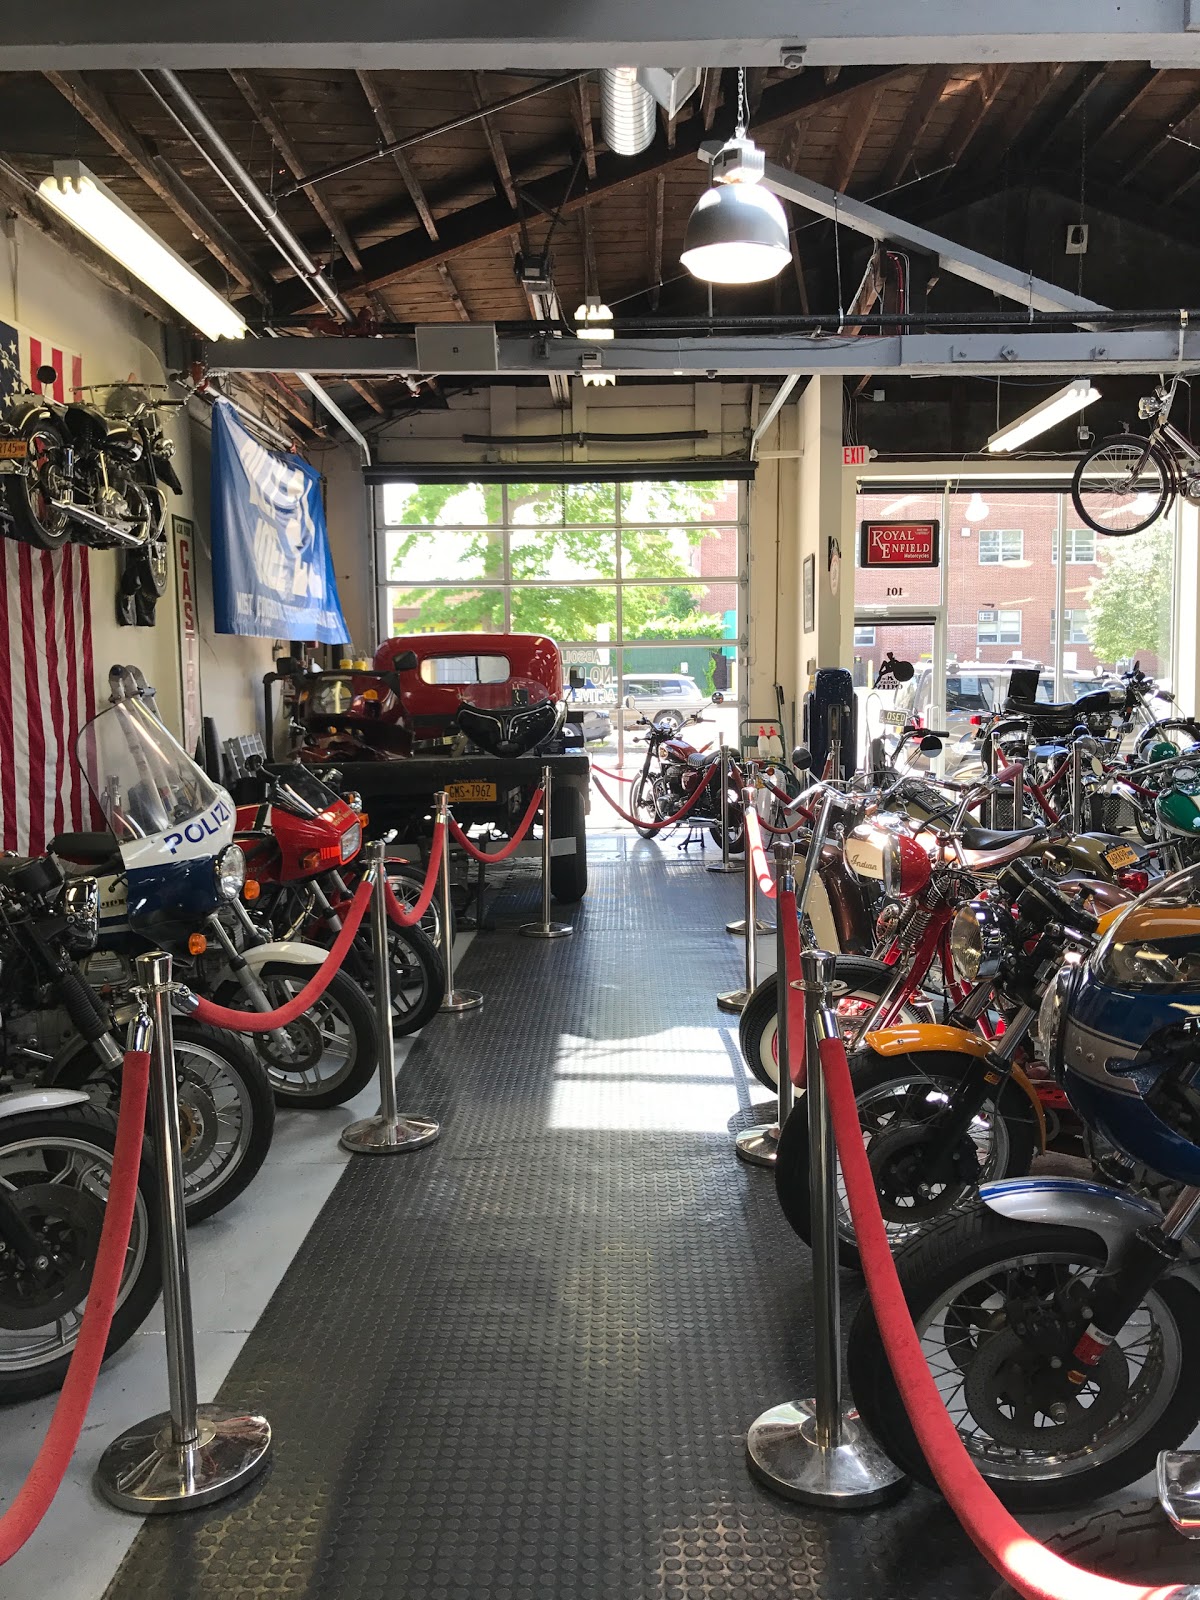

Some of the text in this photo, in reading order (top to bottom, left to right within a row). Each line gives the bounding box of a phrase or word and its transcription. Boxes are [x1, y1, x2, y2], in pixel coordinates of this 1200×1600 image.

[843, 446, 865, 465] EXIT
[871, 530, 915, 549] ROYAL
[881, 543, 930, 559] ENFIELD
[850, 854, 878, 871] Indian
